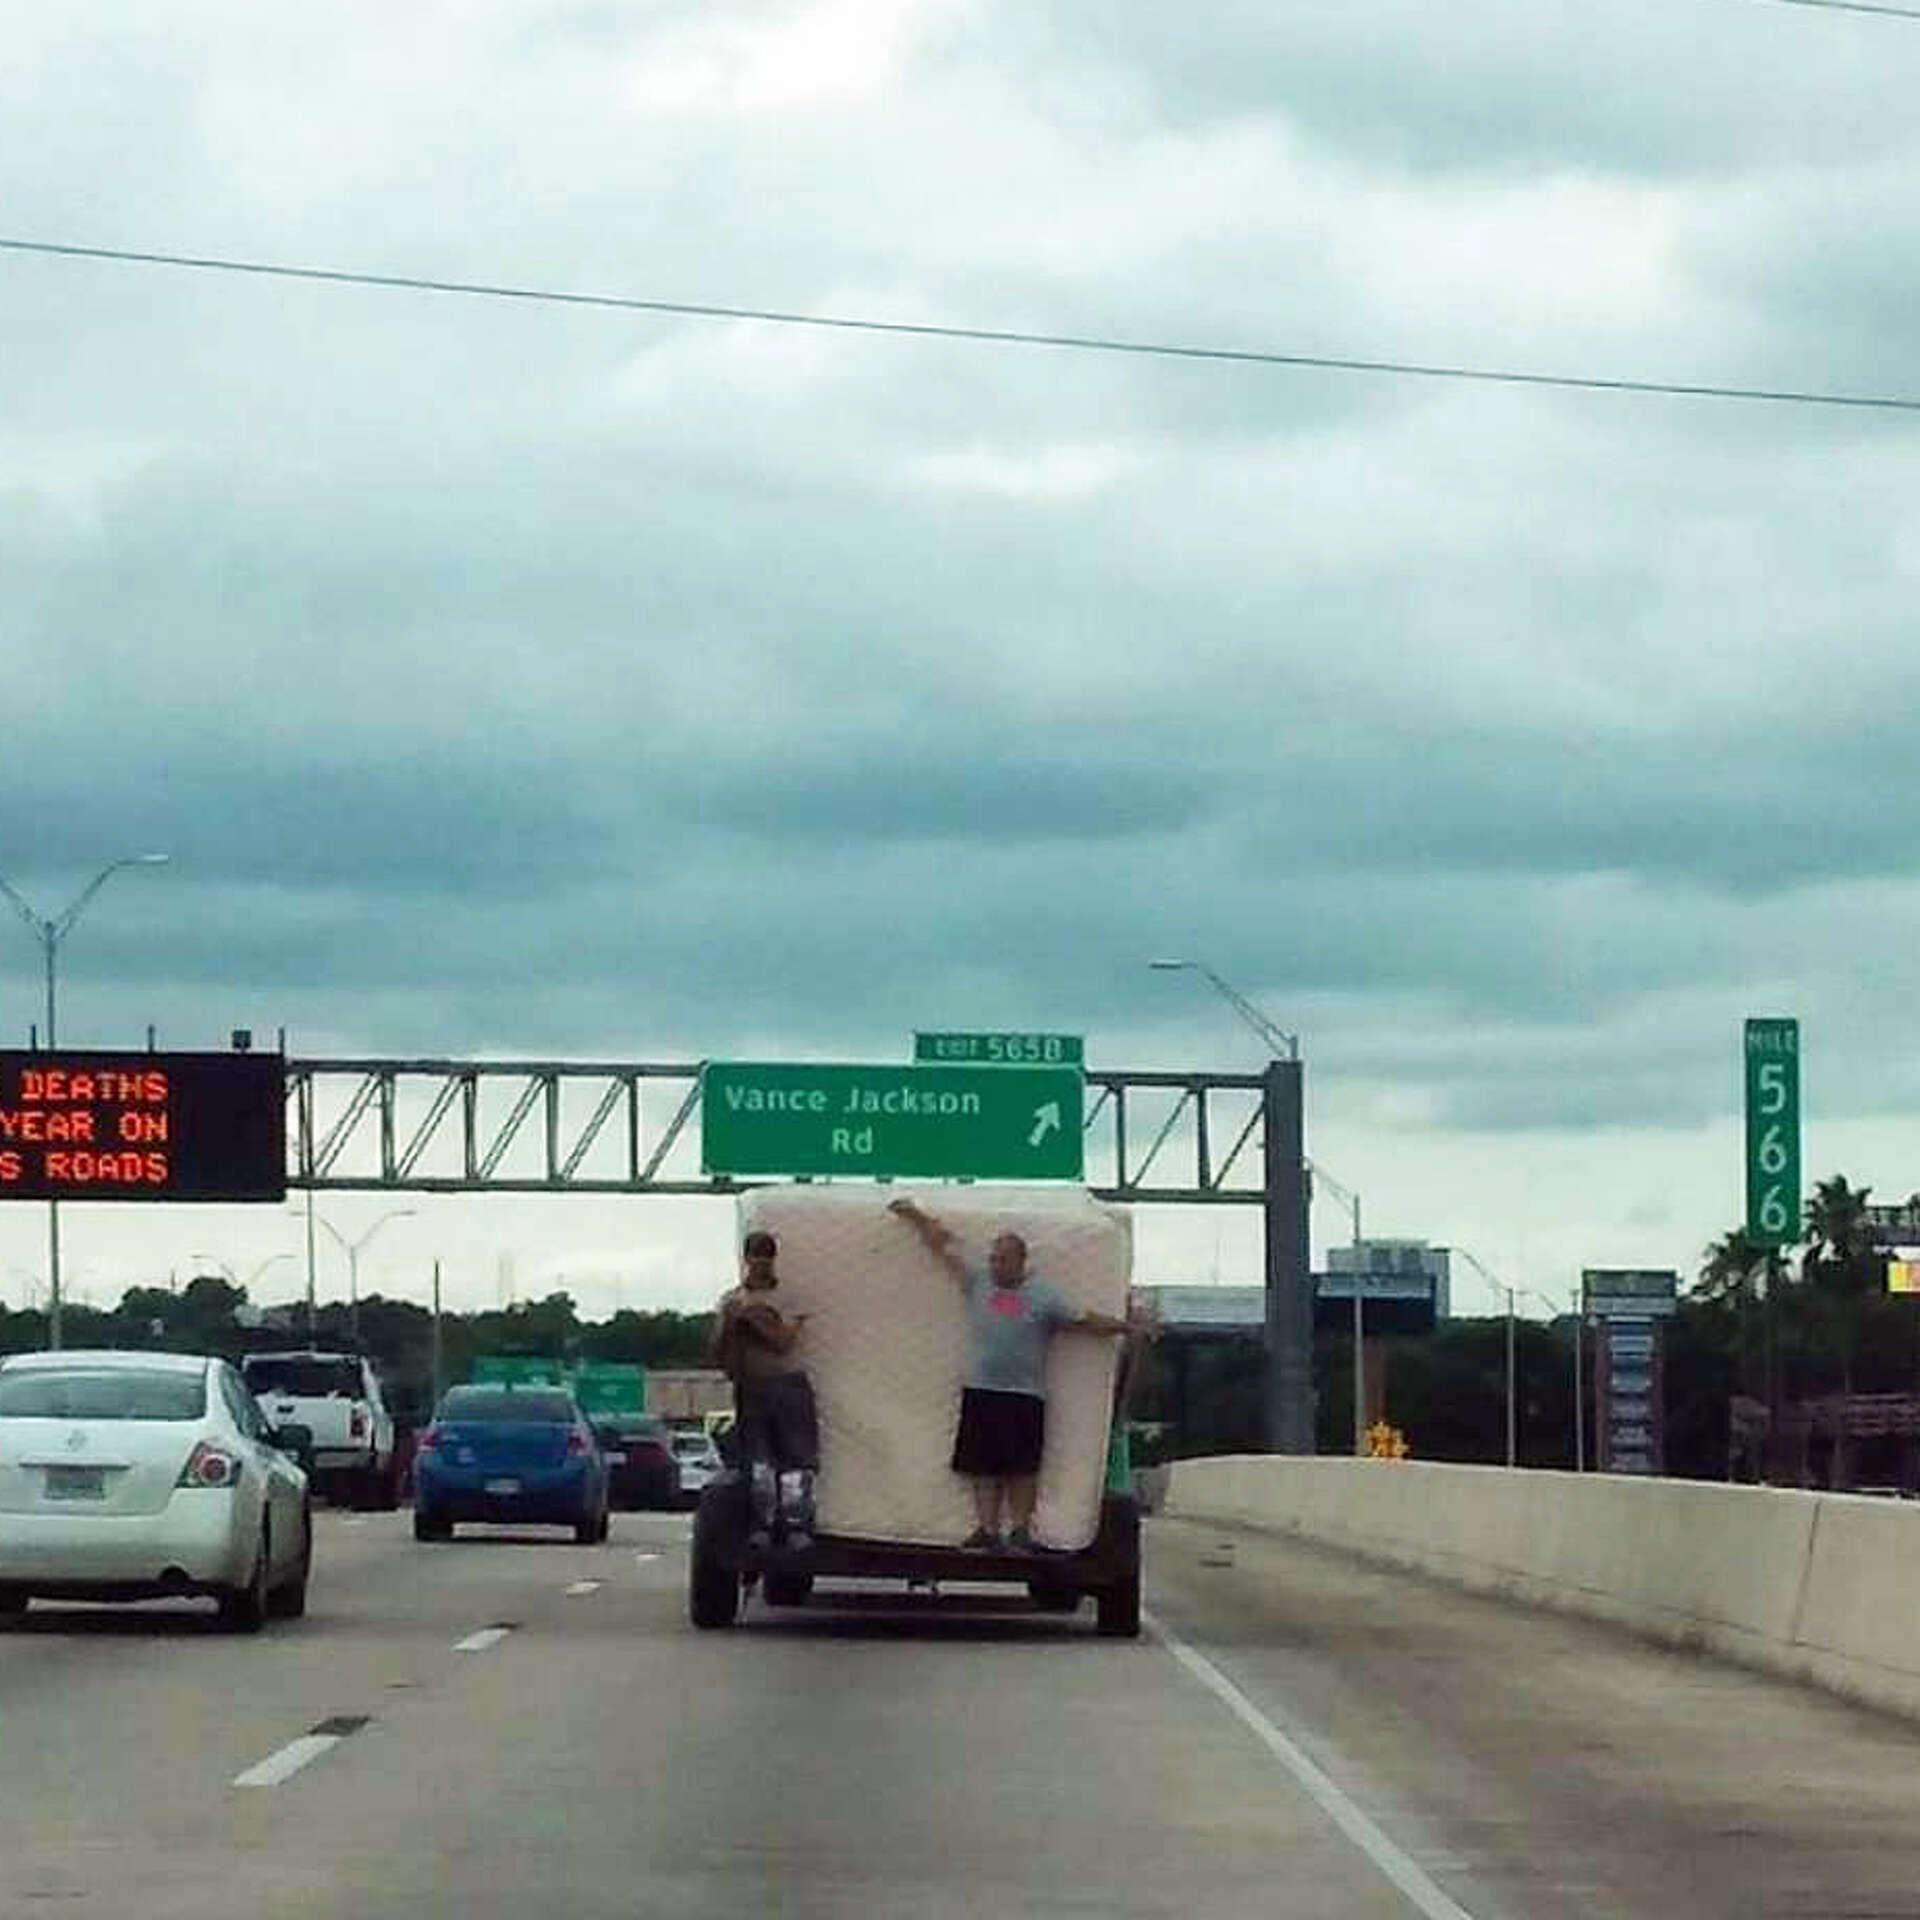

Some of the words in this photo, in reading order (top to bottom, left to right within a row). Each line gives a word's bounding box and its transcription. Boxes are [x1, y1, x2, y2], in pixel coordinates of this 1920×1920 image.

[20, 1070, 168, 1100] DEATHS
[725, 1084, 827, 1112] Vance
[842, 1085, 981, 1115] Jackson
[0, 1110, 94, 1141] YEAR
[118, 1111, 168, 1141] ON
[831, 1127, 873, 1154] Rd
[47, 1152, 168, 1182] ROADS
